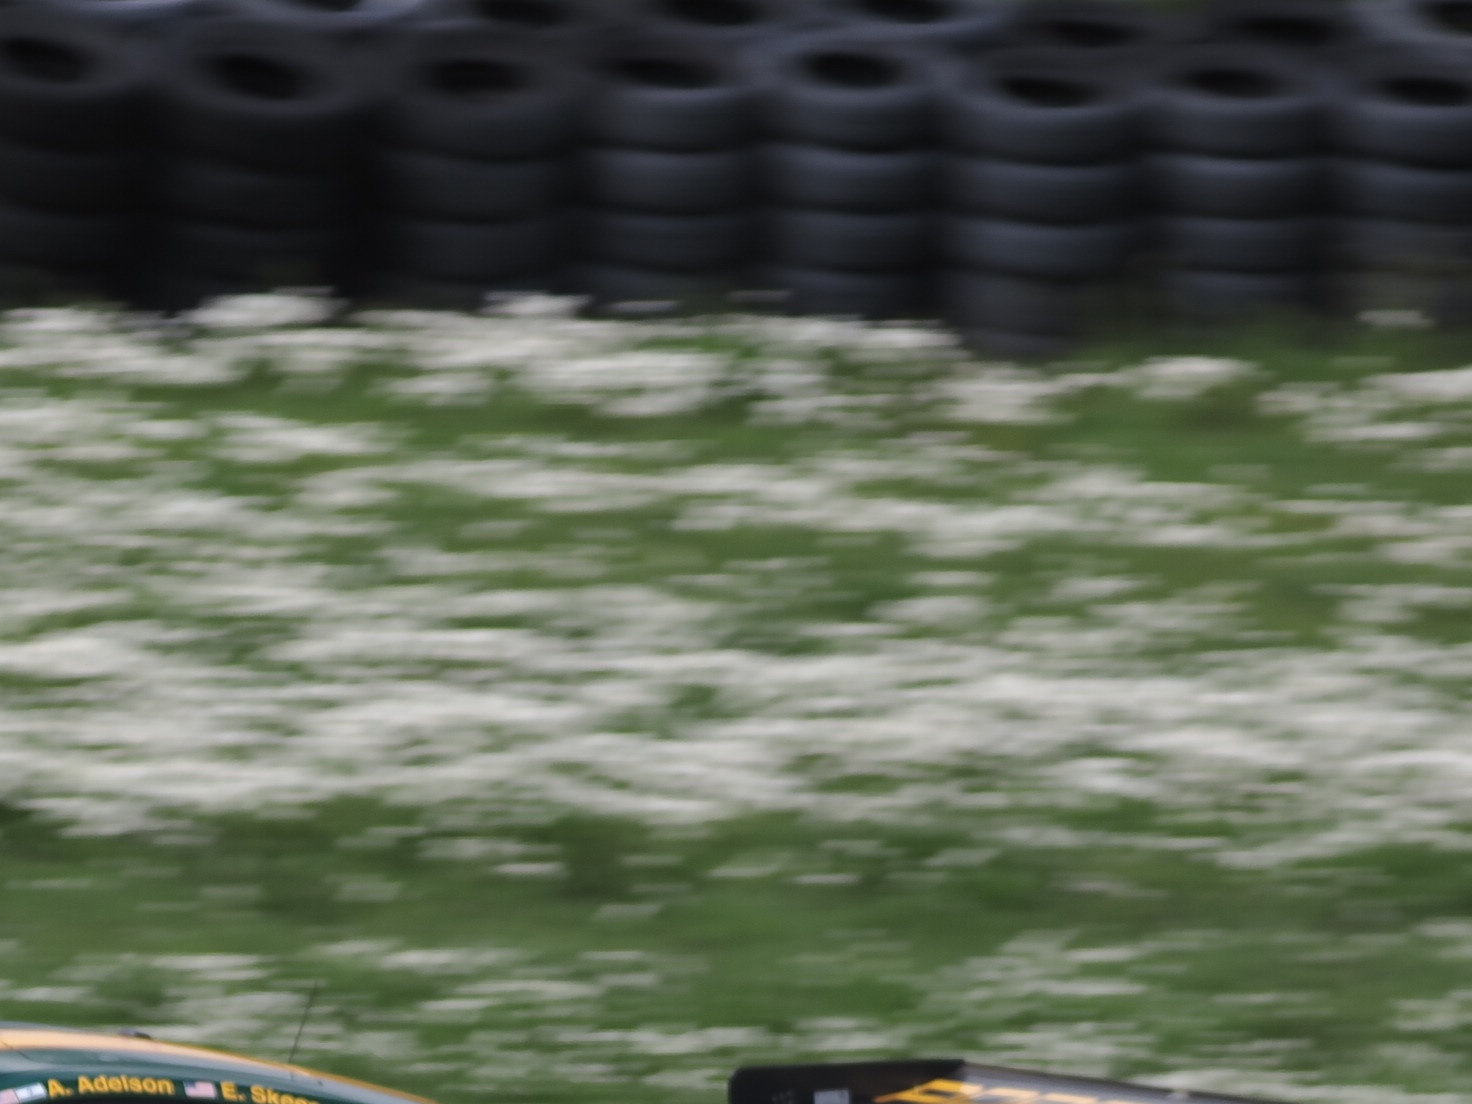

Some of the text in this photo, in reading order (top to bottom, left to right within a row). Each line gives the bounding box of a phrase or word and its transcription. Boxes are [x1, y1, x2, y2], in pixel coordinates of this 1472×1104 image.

[47, 1074, 175, 1098] A. Adelson
[220, 1081, 246, 1101] E.
